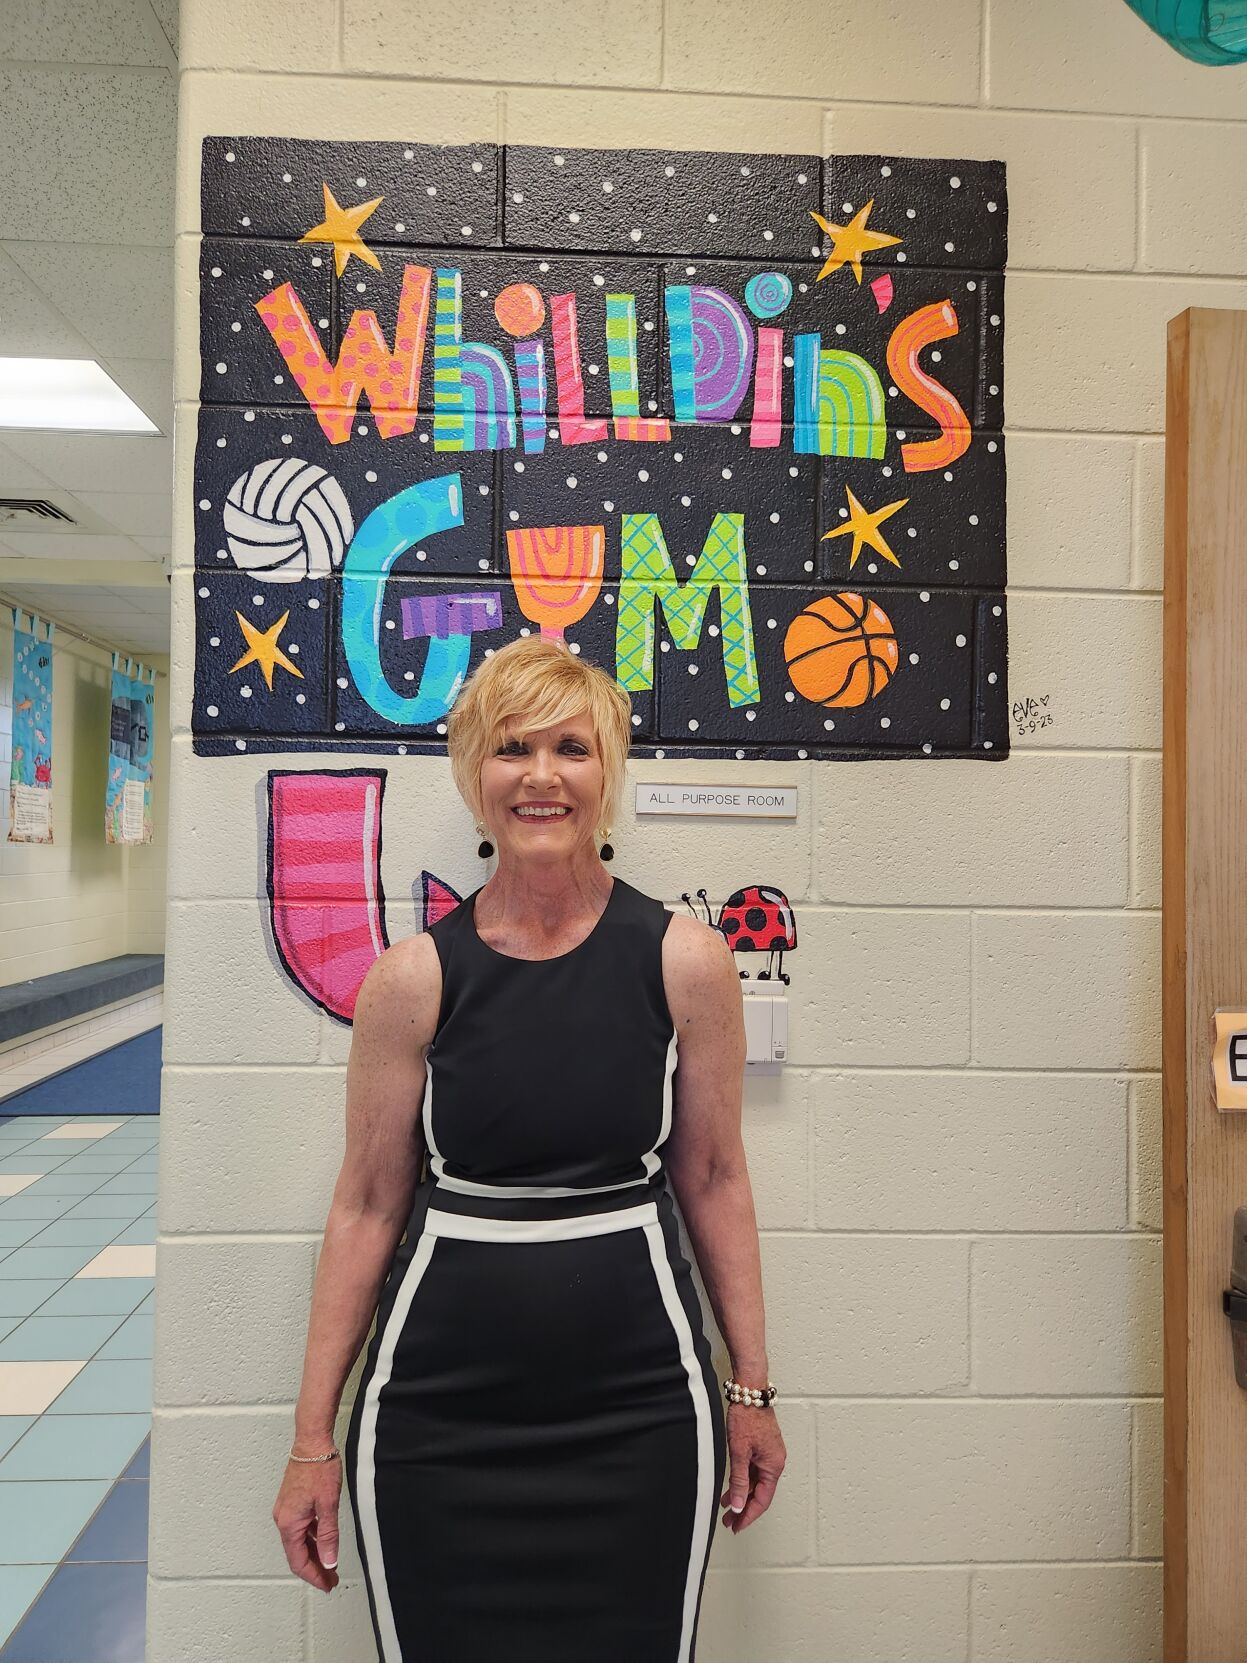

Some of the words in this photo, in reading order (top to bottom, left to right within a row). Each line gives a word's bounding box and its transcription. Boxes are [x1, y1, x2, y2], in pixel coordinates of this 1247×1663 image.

[342, 473, 761, 725] GYM
[1016, 713, 1053, 736] 3-9-23
[649, 793, 675, 804] ALL
[682, 793, 741, 806] PURPOSE
[747, 795, 785, 806] ROOM
